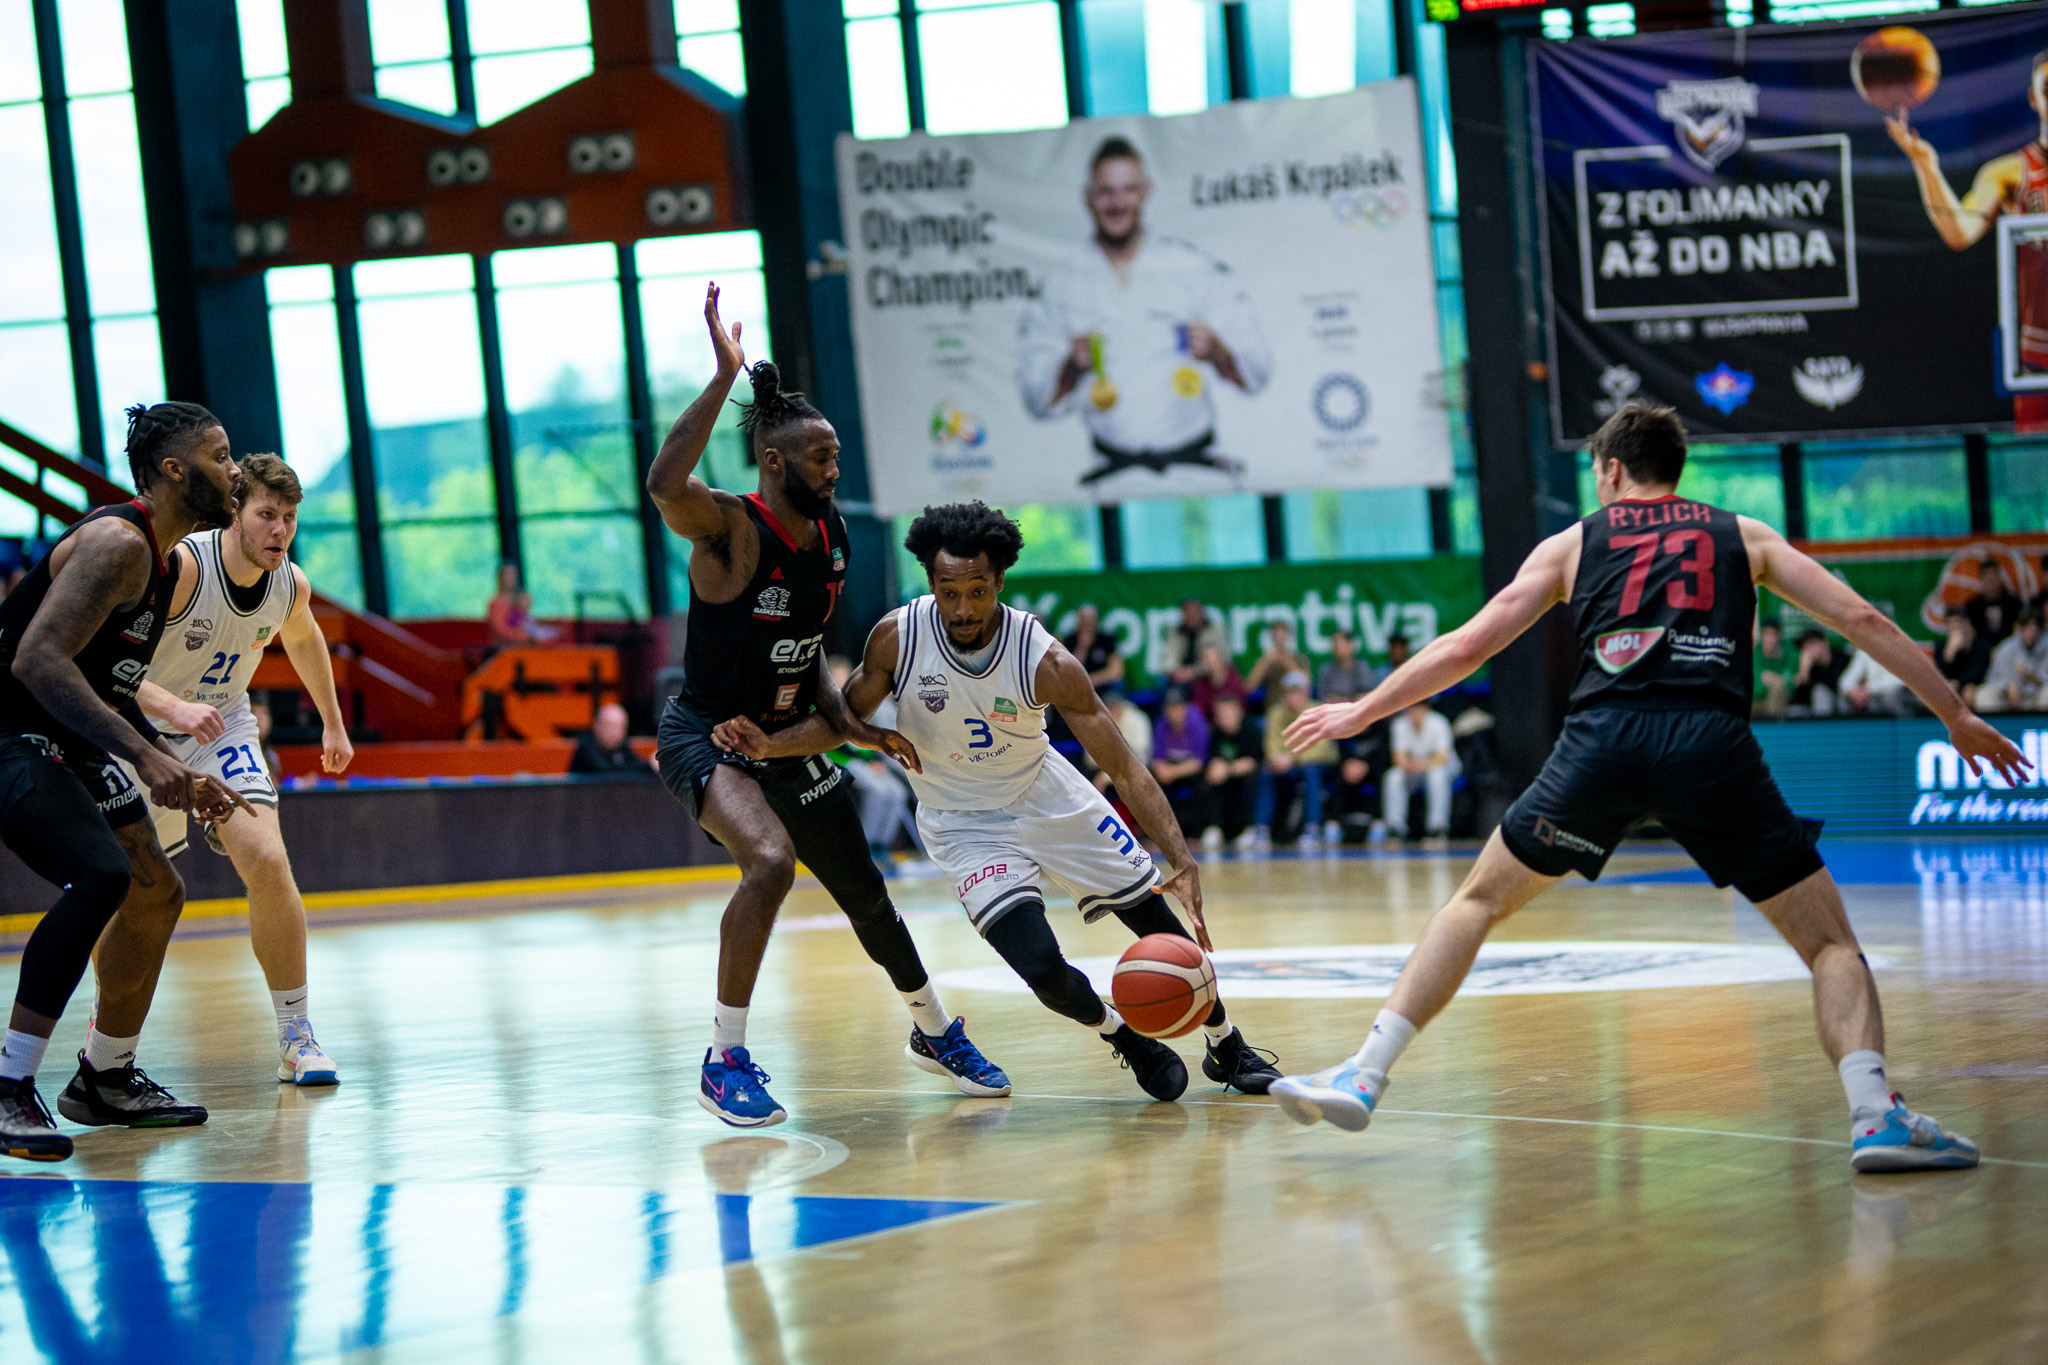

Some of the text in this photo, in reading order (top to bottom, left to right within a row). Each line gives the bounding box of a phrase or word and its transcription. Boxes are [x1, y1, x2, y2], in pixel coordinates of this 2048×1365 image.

[855, 148, 973, 194] Double
[1191, 163, 1280, 208] Lukáš
[1597, 179, 1831, 228] Z FOLIMANKY
[862, 201, 996, 258] Olympic
[1601, 229, 1836, 279] AŽ DO NBA
[1608, 503, 1711, 527] RYLICH
[1608, 529, 1715, 617] 73
[1604, 634, 1641, 655] MOL
[199, 651, 241, 685] 21
[196, 692, 228, 701] VICTORIA
[964, 718, 993, 749] 3
[217, 744, 262, 780] 21
[968, 743, 1012, 763] VICTORIA
[1097, 815, 1134, 856] 3
